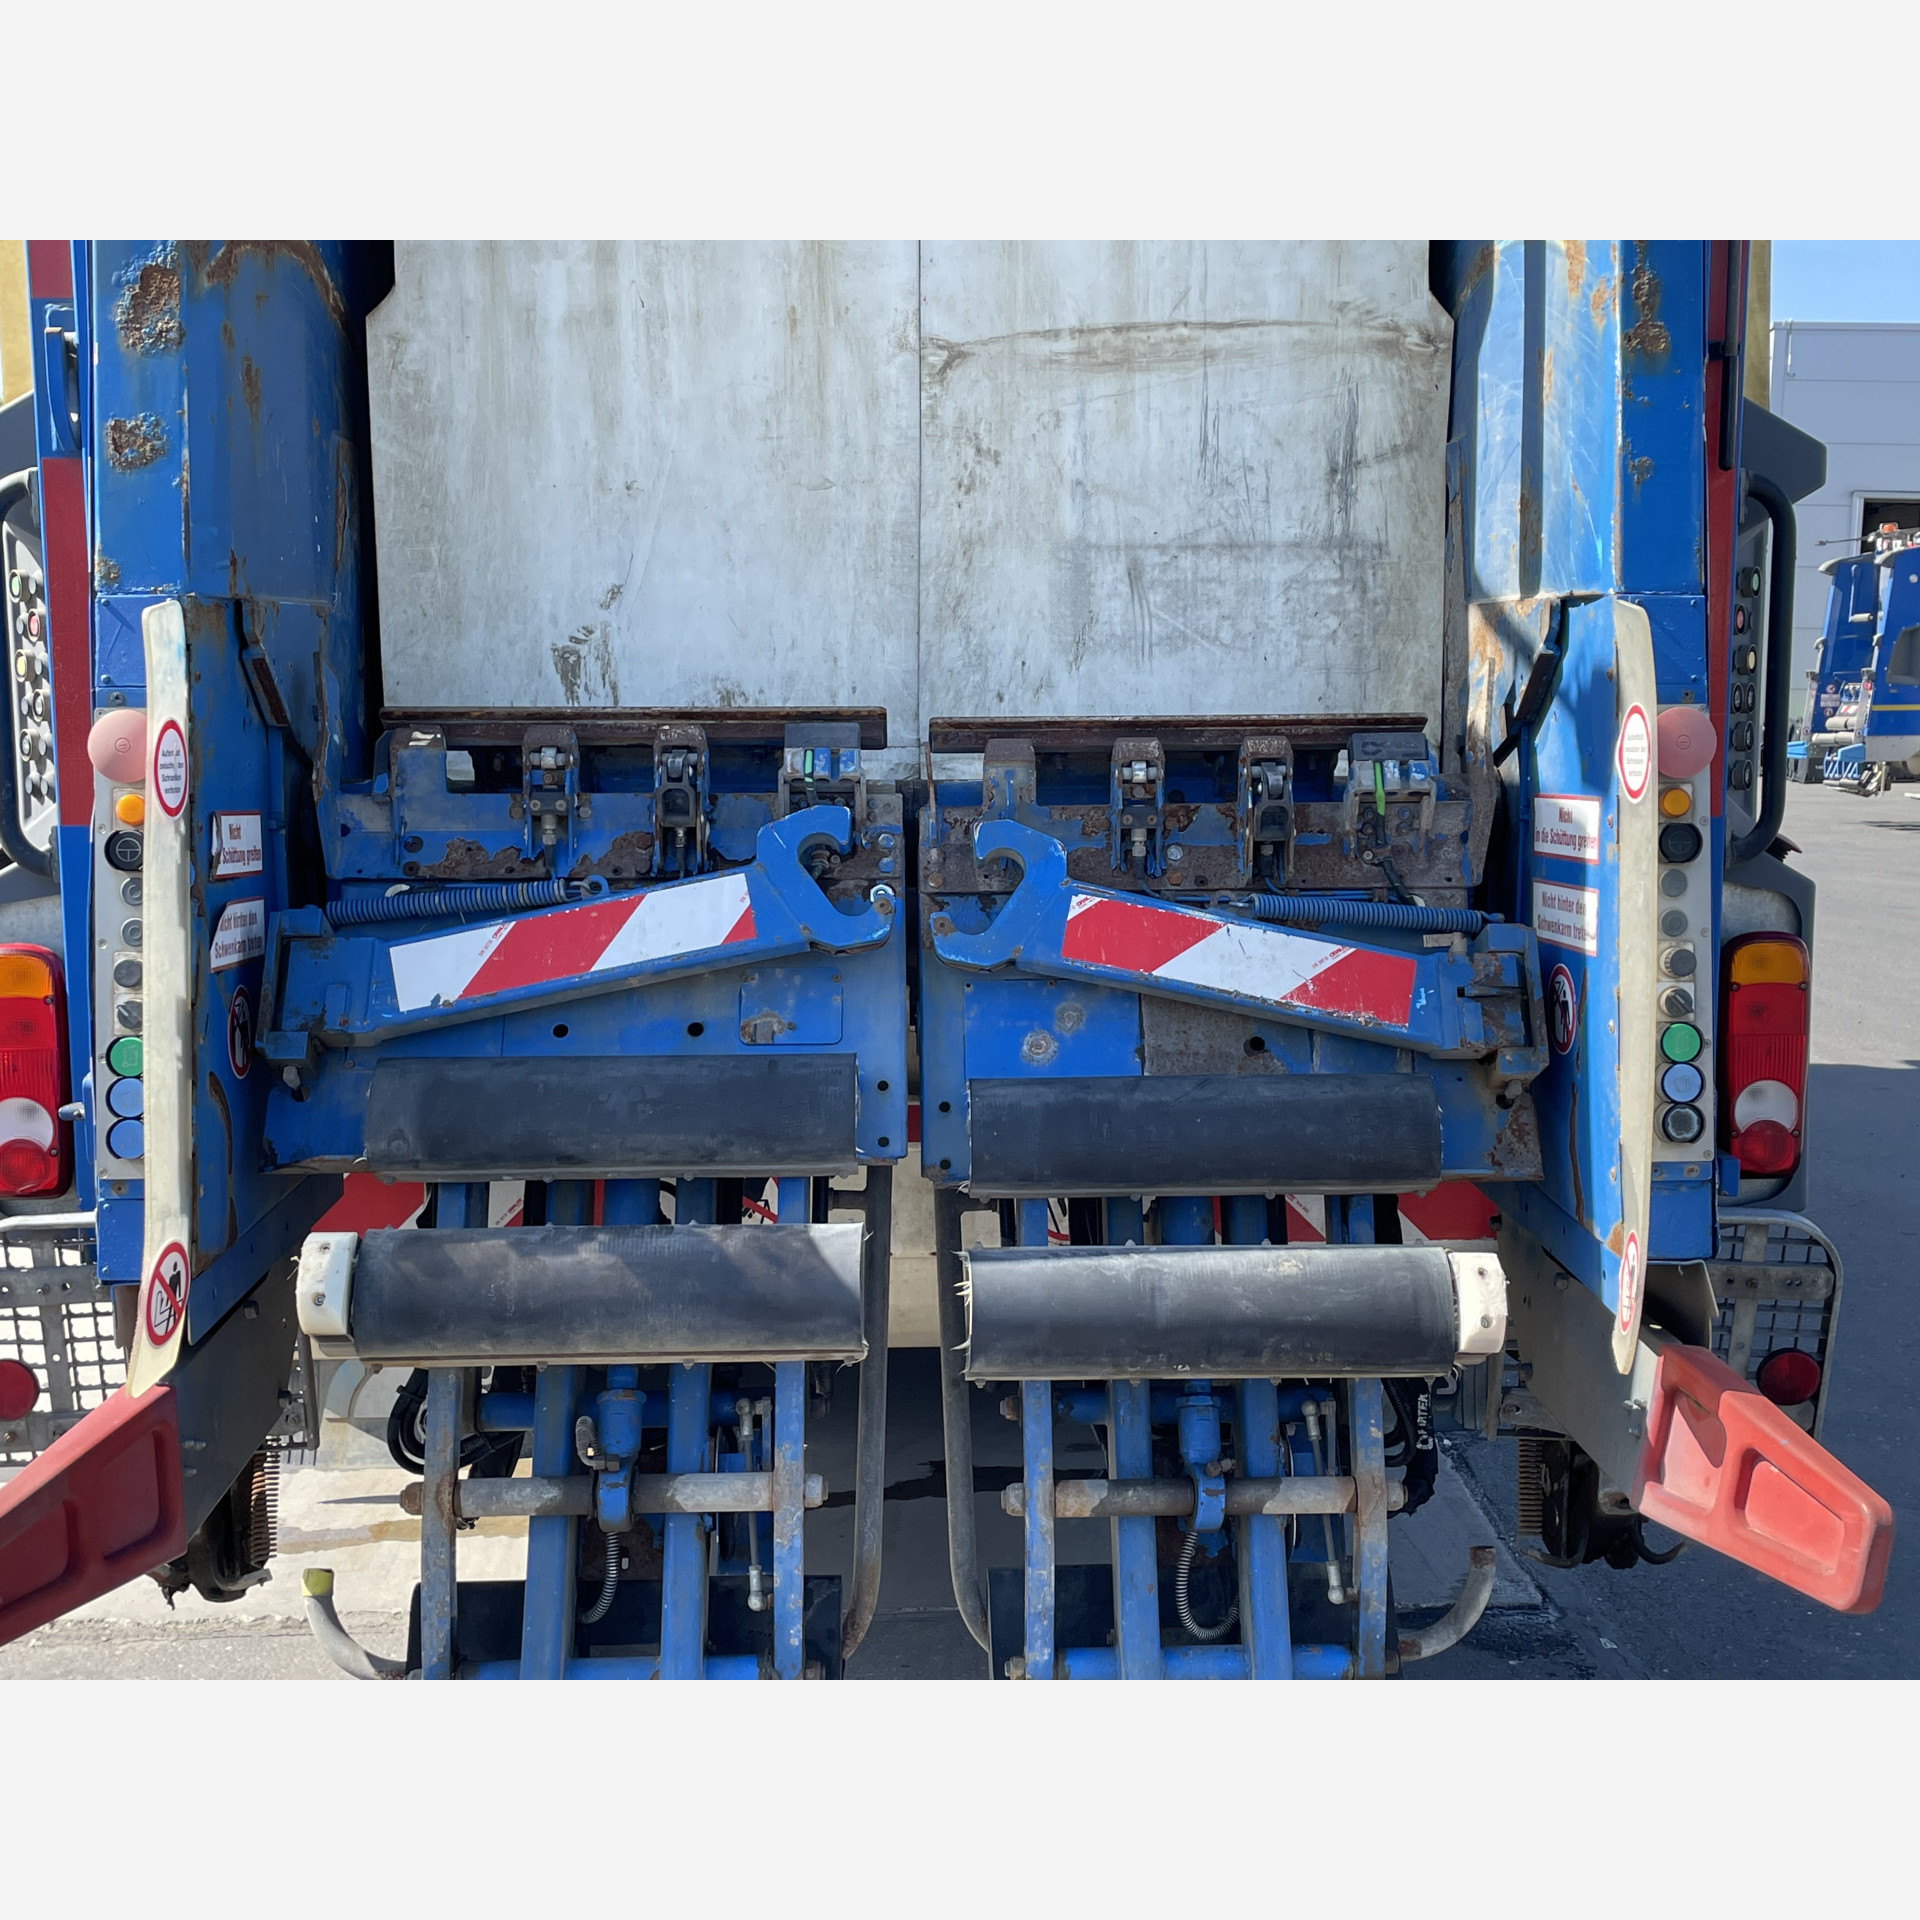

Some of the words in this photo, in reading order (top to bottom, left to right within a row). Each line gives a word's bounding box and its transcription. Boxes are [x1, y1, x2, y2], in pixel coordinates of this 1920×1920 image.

[1558, 806, 1573, 825] Nicht
[229, 823, 242, 840] Nicht
[1535, 826, 1540, 843] in
[1541, 827, 1549, 844] die
[1549, 827, 1577, 851] Schüttung
[1541, 890, 1557, 909] Nicht
[1557, 893, 1575, 913] hinter
[1537, 914, 1572, 938] Schwenkarm
